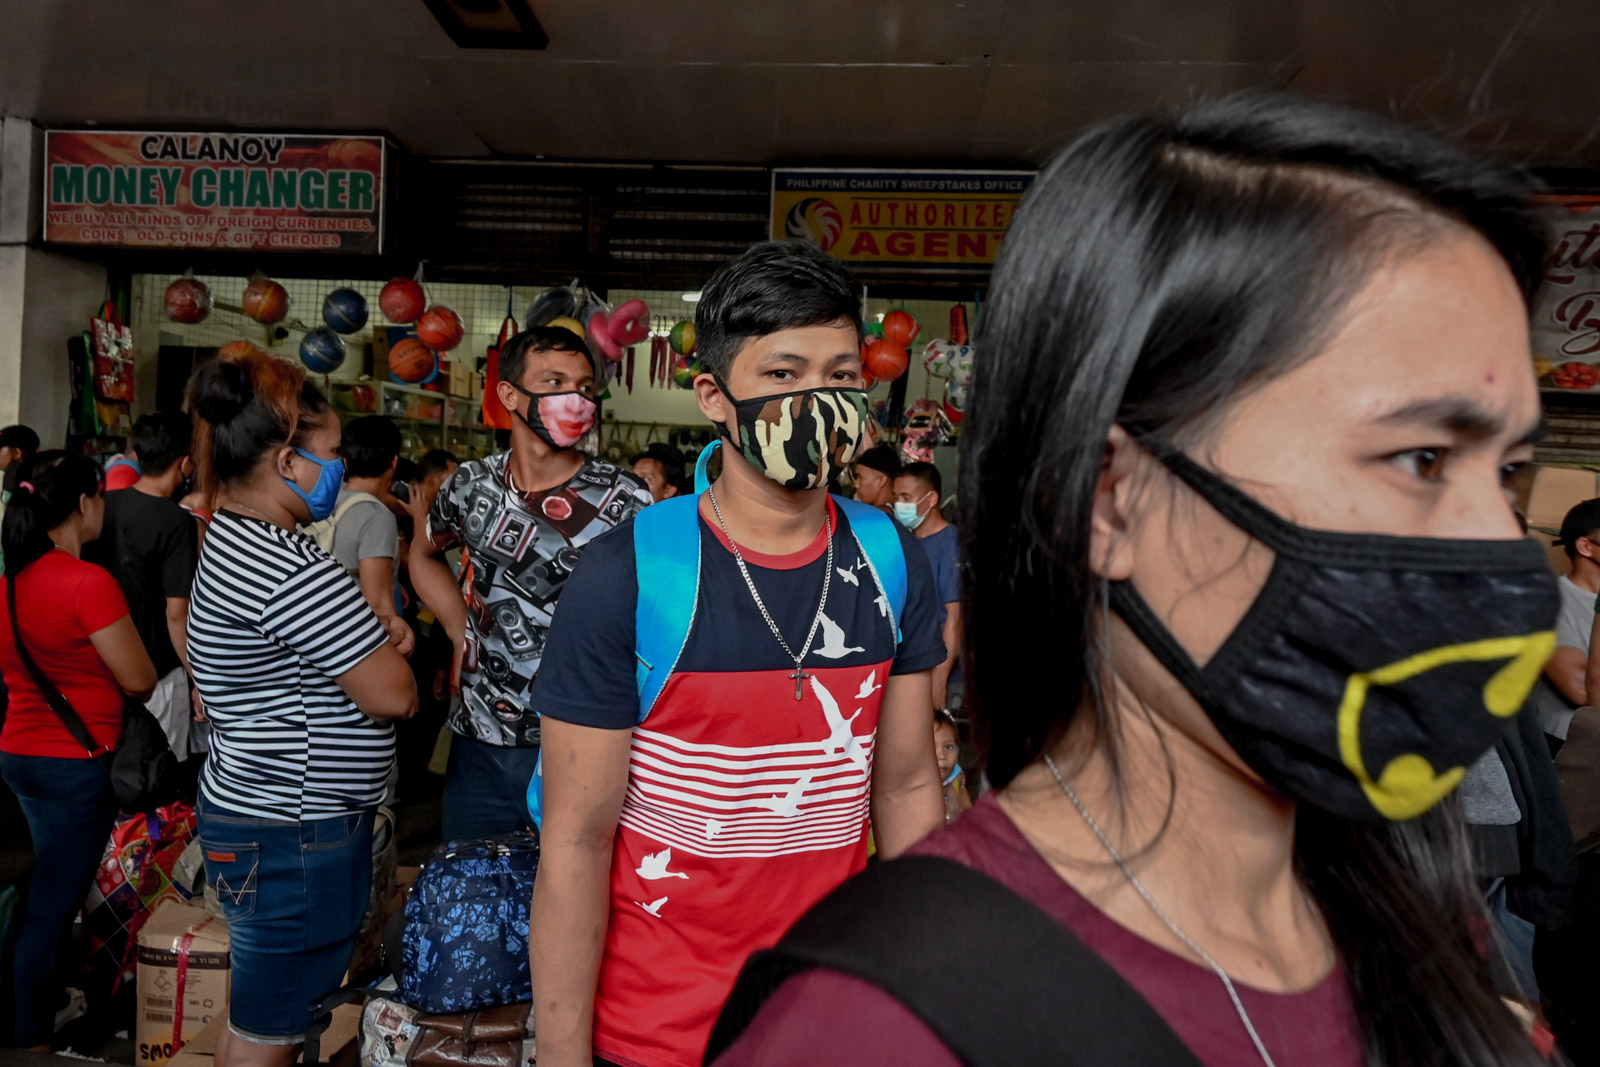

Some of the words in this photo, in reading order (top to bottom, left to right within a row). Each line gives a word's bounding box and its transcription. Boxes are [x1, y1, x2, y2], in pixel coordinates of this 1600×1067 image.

[142, 136, 285, 162] CALANOY
[52, 165, 183, 206] MONEY
[192, 168, 375, 210] CHANGER
[786, 178, 848, 189] PHILIPPINE
[850, 179, 898, 190] CHARITY
[901, 179, 982, 191] SWEEPSTAKES
[984, 181, 1025, 191] OFFICE
[49, 212, 71, 225] WE
[74, 213, 101, 225] BUY
[107, 215, 133, 225] ALL
[137, 215, 182, 227] KINDS
[186, 216, 206, 227] OF
[82, 229, 126, 241] COINS
[137, 231, 213, 243] OLD-COINS
[219, 232, 228, 243] &
[233, 233, 267, 245] GIFT
[270, 233, 341, 247] CHEQUES
